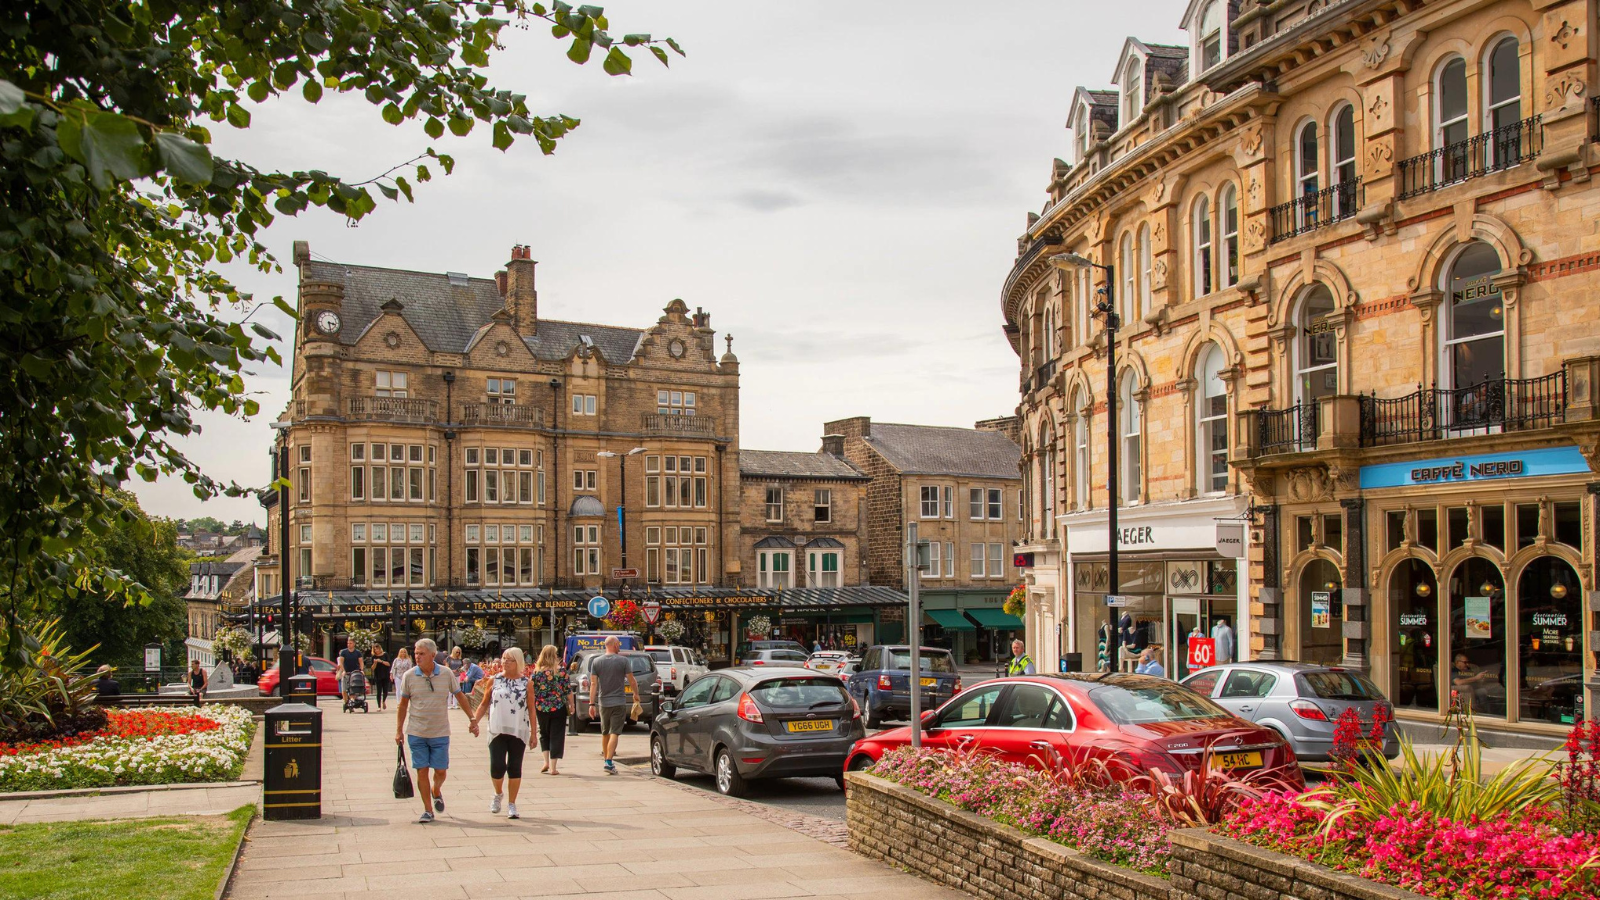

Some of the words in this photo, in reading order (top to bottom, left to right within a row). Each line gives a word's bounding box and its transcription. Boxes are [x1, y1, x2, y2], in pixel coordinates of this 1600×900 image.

[1411, 461, 1464, 481] CAFFÈ
[1470, 460, 1523, 477] NERO
[545, 600, 577, 608] BLENDERS
[665, 597, 714, 605] CONFECTIONERS
[355, 604, 382, 612] COFFEE
[1400, 617, 1427, 625] SUMMER
[1532, 617, 1567, 626] SUMMER
[791, 721, 813, 730] YG66
[815, 721, 830, 729] UGH
[1223, 755, 1236, 767] 54
